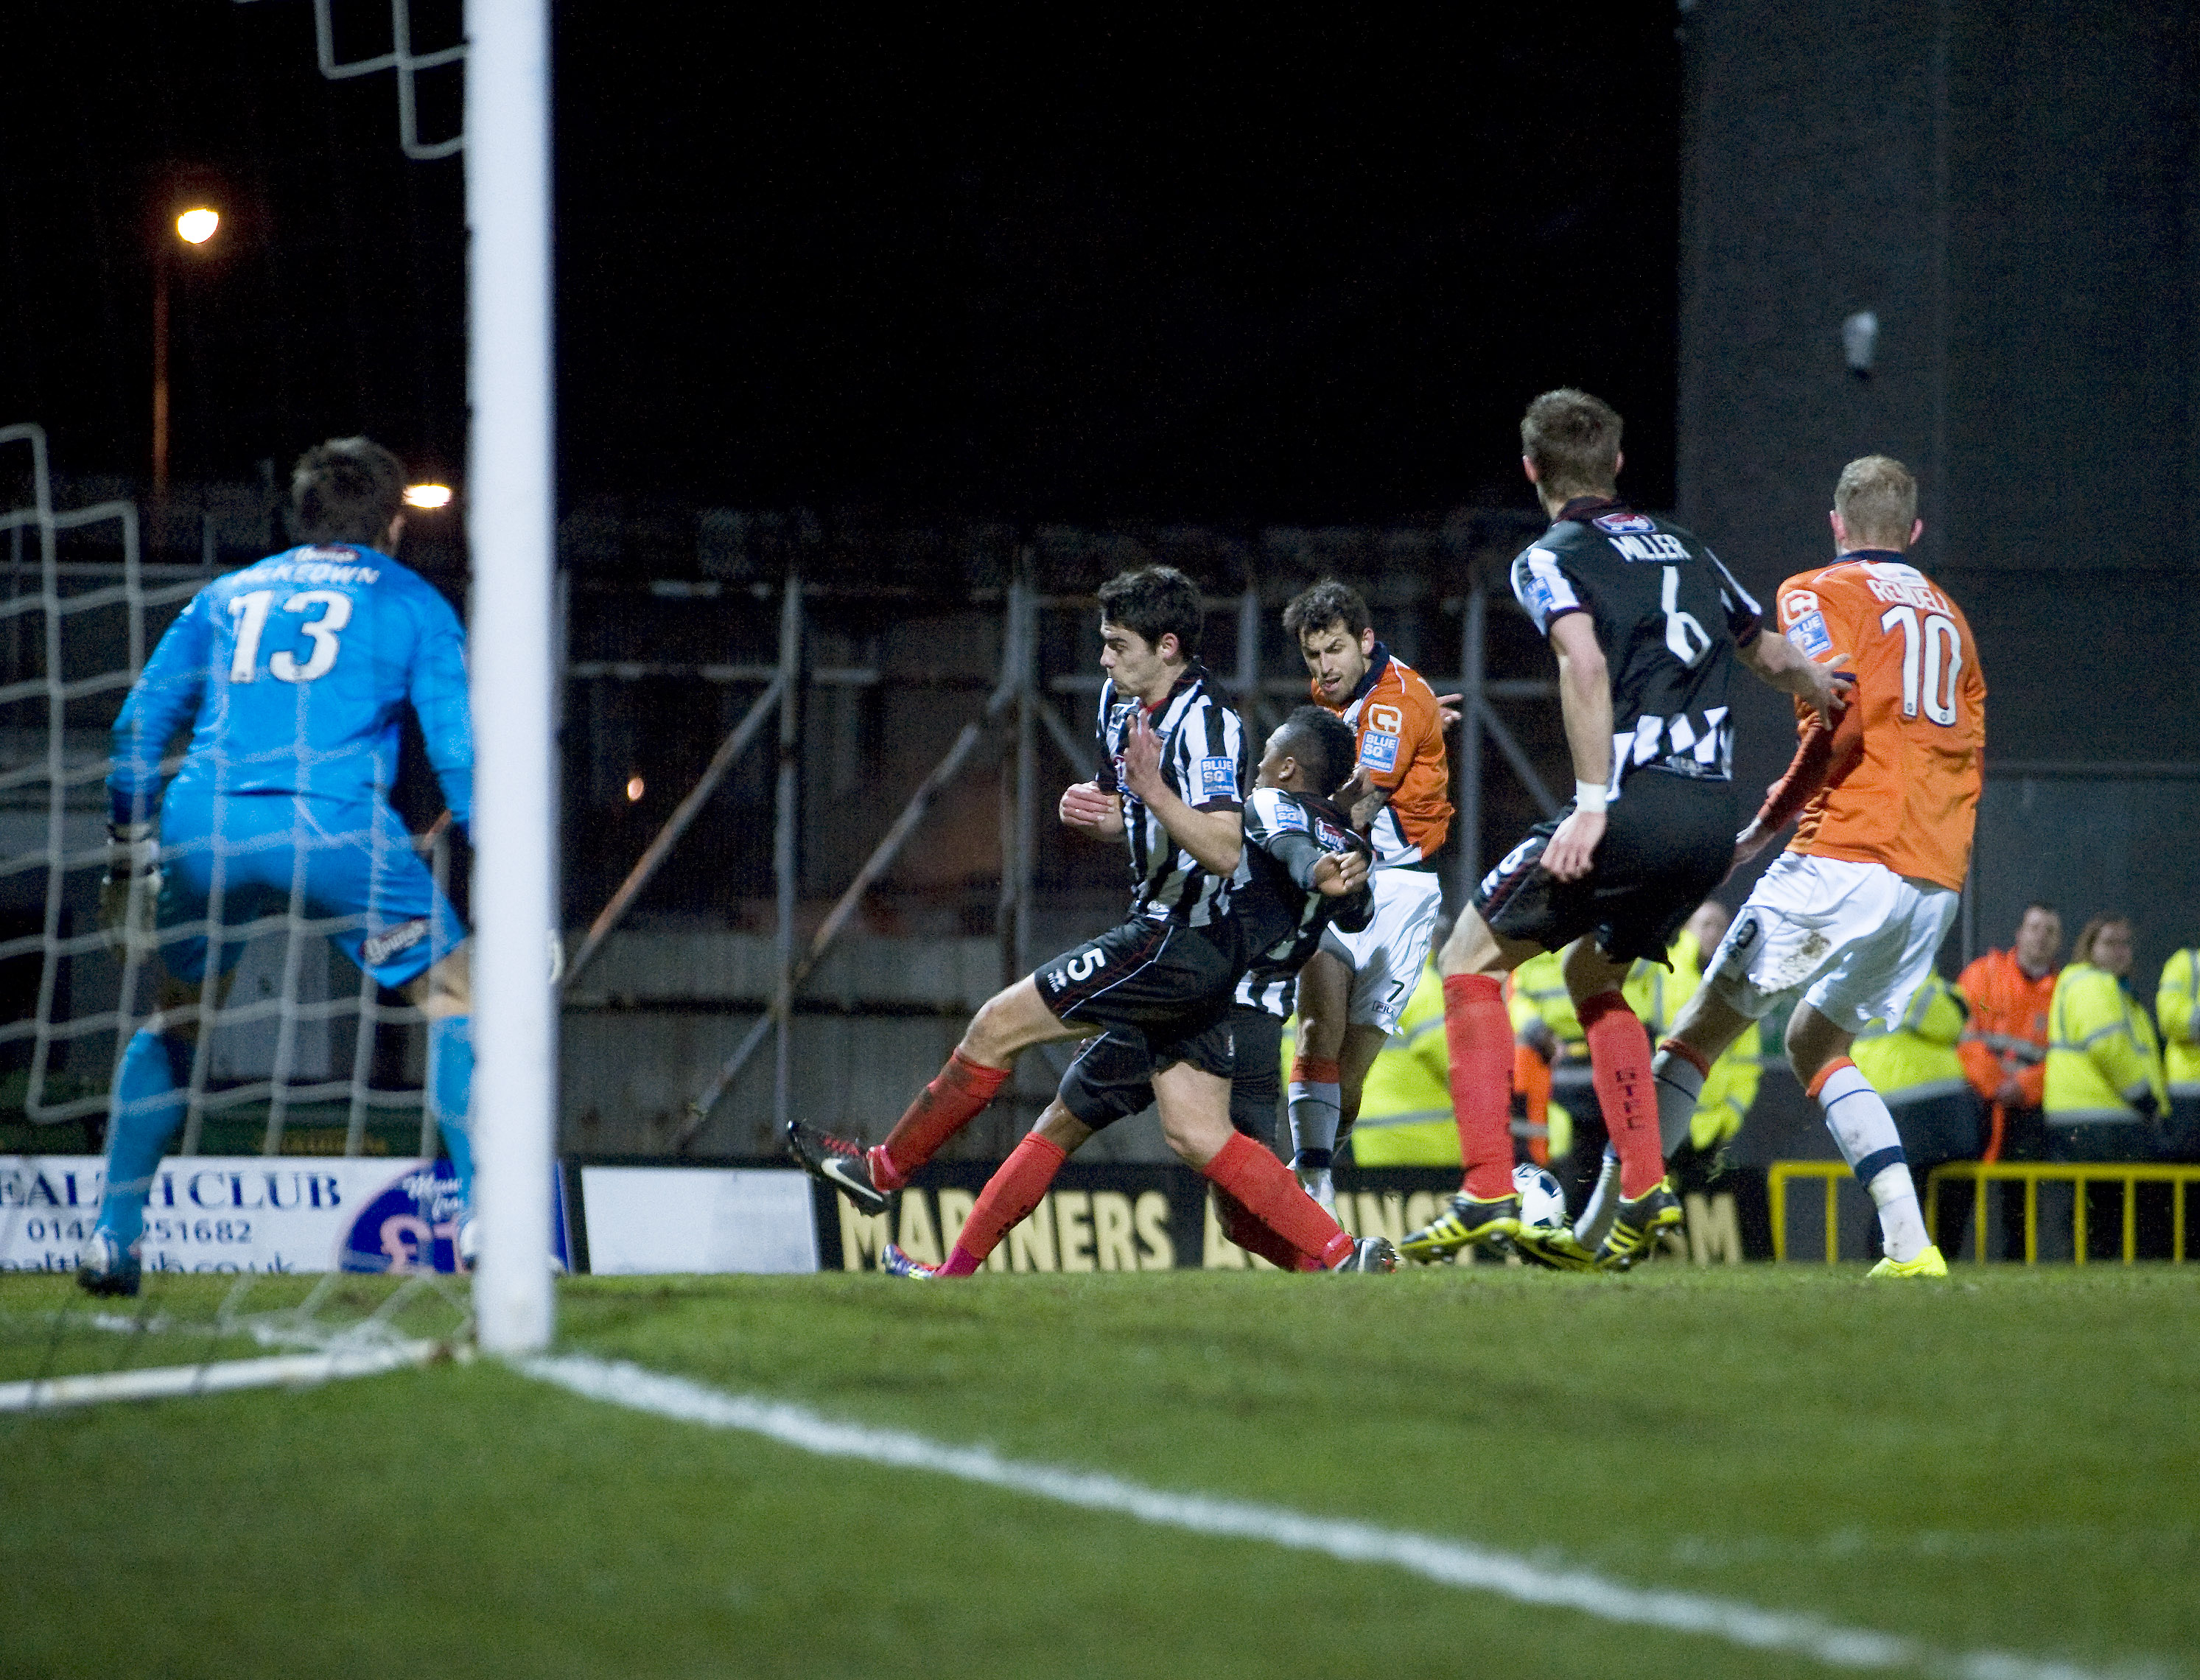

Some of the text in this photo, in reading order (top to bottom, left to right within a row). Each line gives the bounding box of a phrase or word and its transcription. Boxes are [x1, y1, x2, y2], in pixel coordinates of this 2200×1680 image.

[1608, 533, 1692, 562] MILLER
[1661, 564, 1711, 665] 6
[228, 589, 353, 684] 13
[1880, 604, 1962, 727] 10
[1363, 743, 1384, 758] SQ
[1365, 733, 1397, 749] BLUE
[1202, 760, 1233, 771] BLUE
[1203, 770, 1225, 783] SQ
[1067, 947, 1106, 981] 5
[1386, 979, 1405, 1003] 7
[187, 1170, 341, 1208] CLUB
[837, 1187, 1175, 1274] MARNERS
